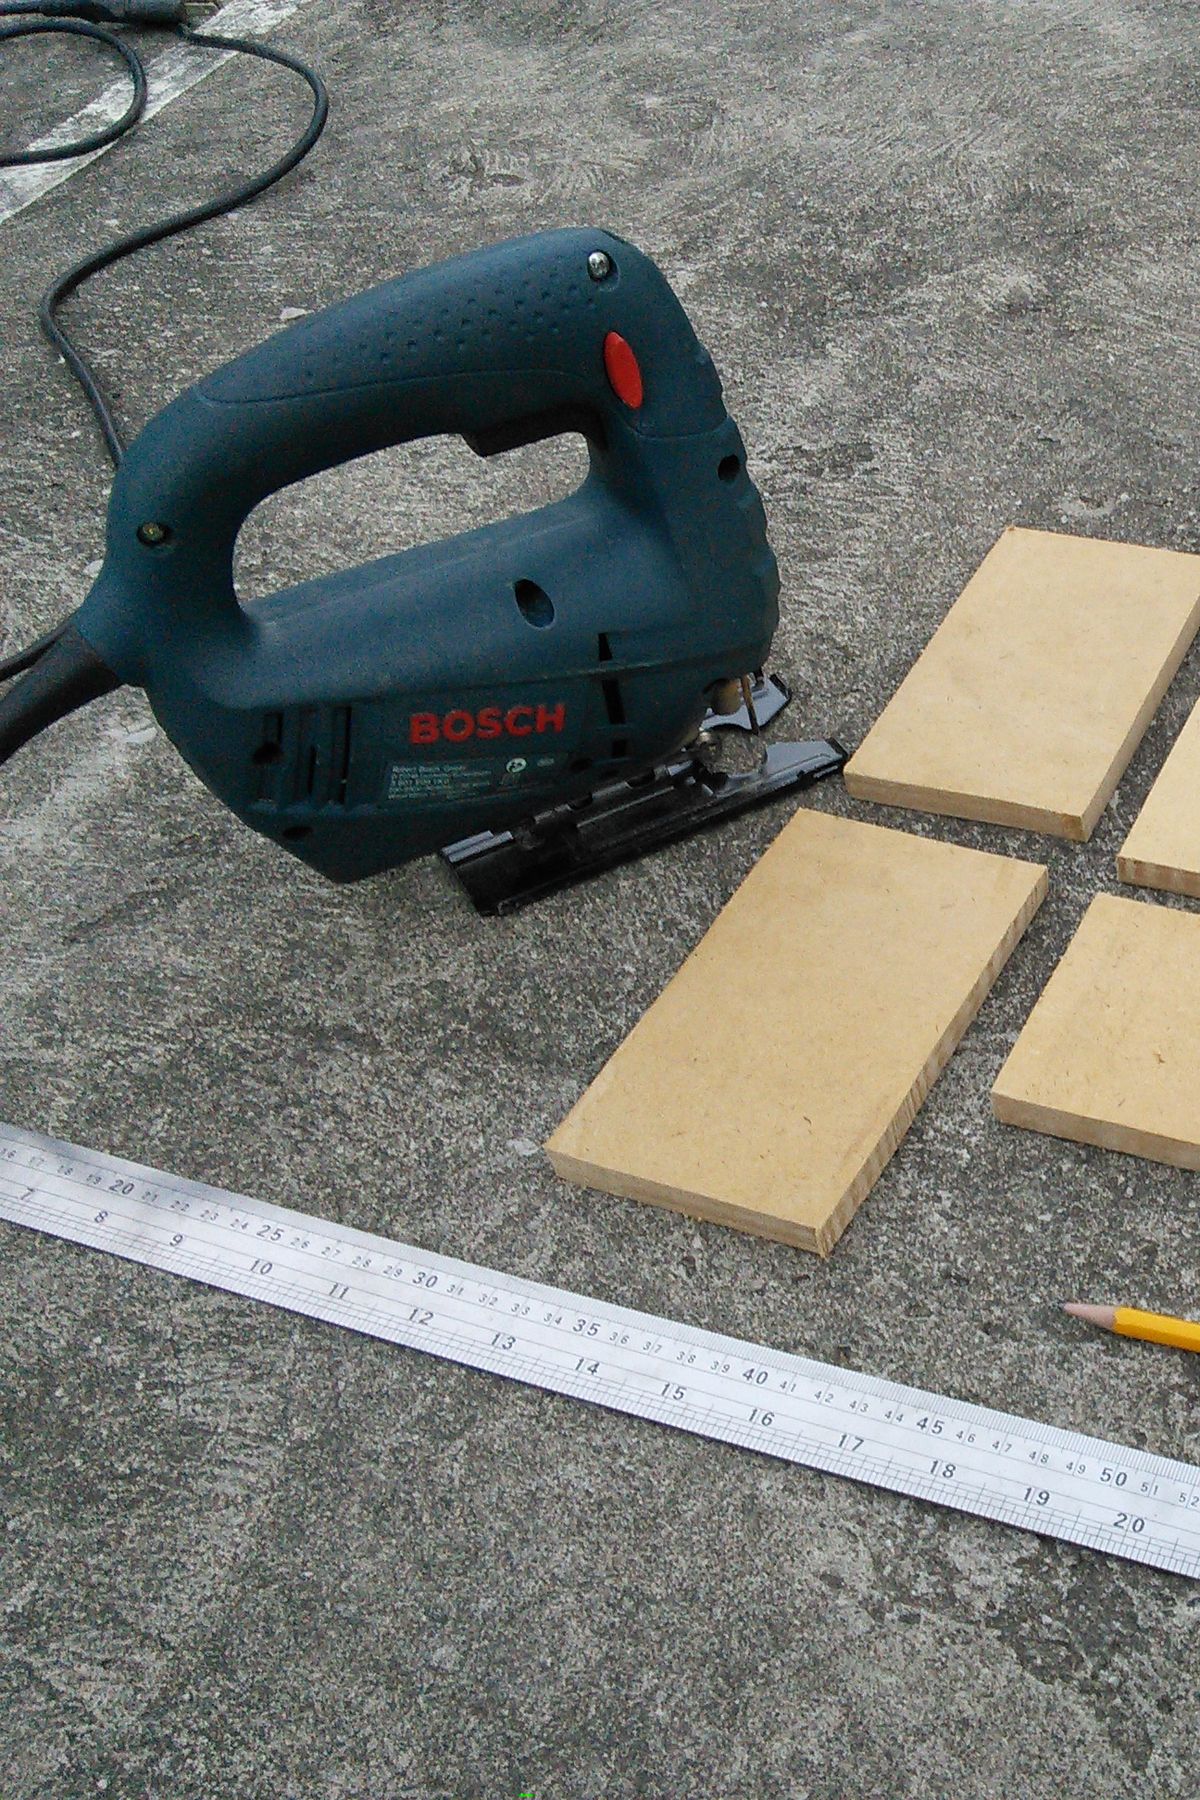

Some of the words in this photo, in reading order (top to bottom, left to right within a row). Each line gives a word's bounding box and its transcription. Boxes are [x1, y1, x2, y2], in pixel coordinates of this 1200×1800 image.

[409, 703, 566, 744] BOSCH
[20, 1186, 35, 1201] 7
[94, 1210, 108, 1223] 8
[170, 1234, 184, 1247] 9
[250, 1259, 273, 1275] 10
[328, 1282, 349, 1299] 11
[407, 1308, 435, 1326] 12
[491, 1332, 517, 1350] 13
[574, 1358, 601, 1376] 14
[660, 1382, 688, 1401] 15
[748, 1408, 776, 1427] 16
[837, 1433, 865, 1452] 17
[929, 1459, 957, 1479] 18
[1024, 1487, 1051, 1506] 19
[1113, 1512, 1146, 1533] 20
[109, 1179, 136, 1195] 20
[142, 1190, 158, 1202] 21
[170, 1199, 189, 1212] 22
[200, 1210, 219, 1221] 23
[230, 1218, 249, 1230] 24
[256, 1224, 285, 1241] 25
[290, 1236, 310, 1249] 26
[321, 1246, 341, 1258] 27
[351, 1256, 372, 1269] 28
[383, 1265, 403, 1278] 29
[412, 1271, 438, 1288] 30
[446, 1284, 463, 1296] 31
[478, 1293, 498, 1306] 32
[511, 1303, 531, 1316] 33
[544, 1313, 562, 1326] 34
[572, 1319, 601, 1337] 35
[609, 1331, 630, 1345] 36
[642, 1341, 663, 1354] 37
[676, 1350, 697, 1364] 38
[710, 1360, 731, 1374] 39
[742, 1367, 769, 1385] 40
[779, 1380, 797, 1393] 41
[813, 1390, 835, 1404] 42
[848, 1399, 870, 1413] 43
[884, 1409, 905, 1424] 44
[915, 1416, 946, 1435] 45
[955, 1430, 976, 1444] 46
[991, 1440, 1013, 1453] 47
[1028, 1450, 1050, 1464] 48
[1065, 1461, 1087, 1475] 49
[1099, 1467, 1128, 1487] 50
[1140, 1481, 1160, 1496] 51
[1178, 1492, 1200, 1508] 52
